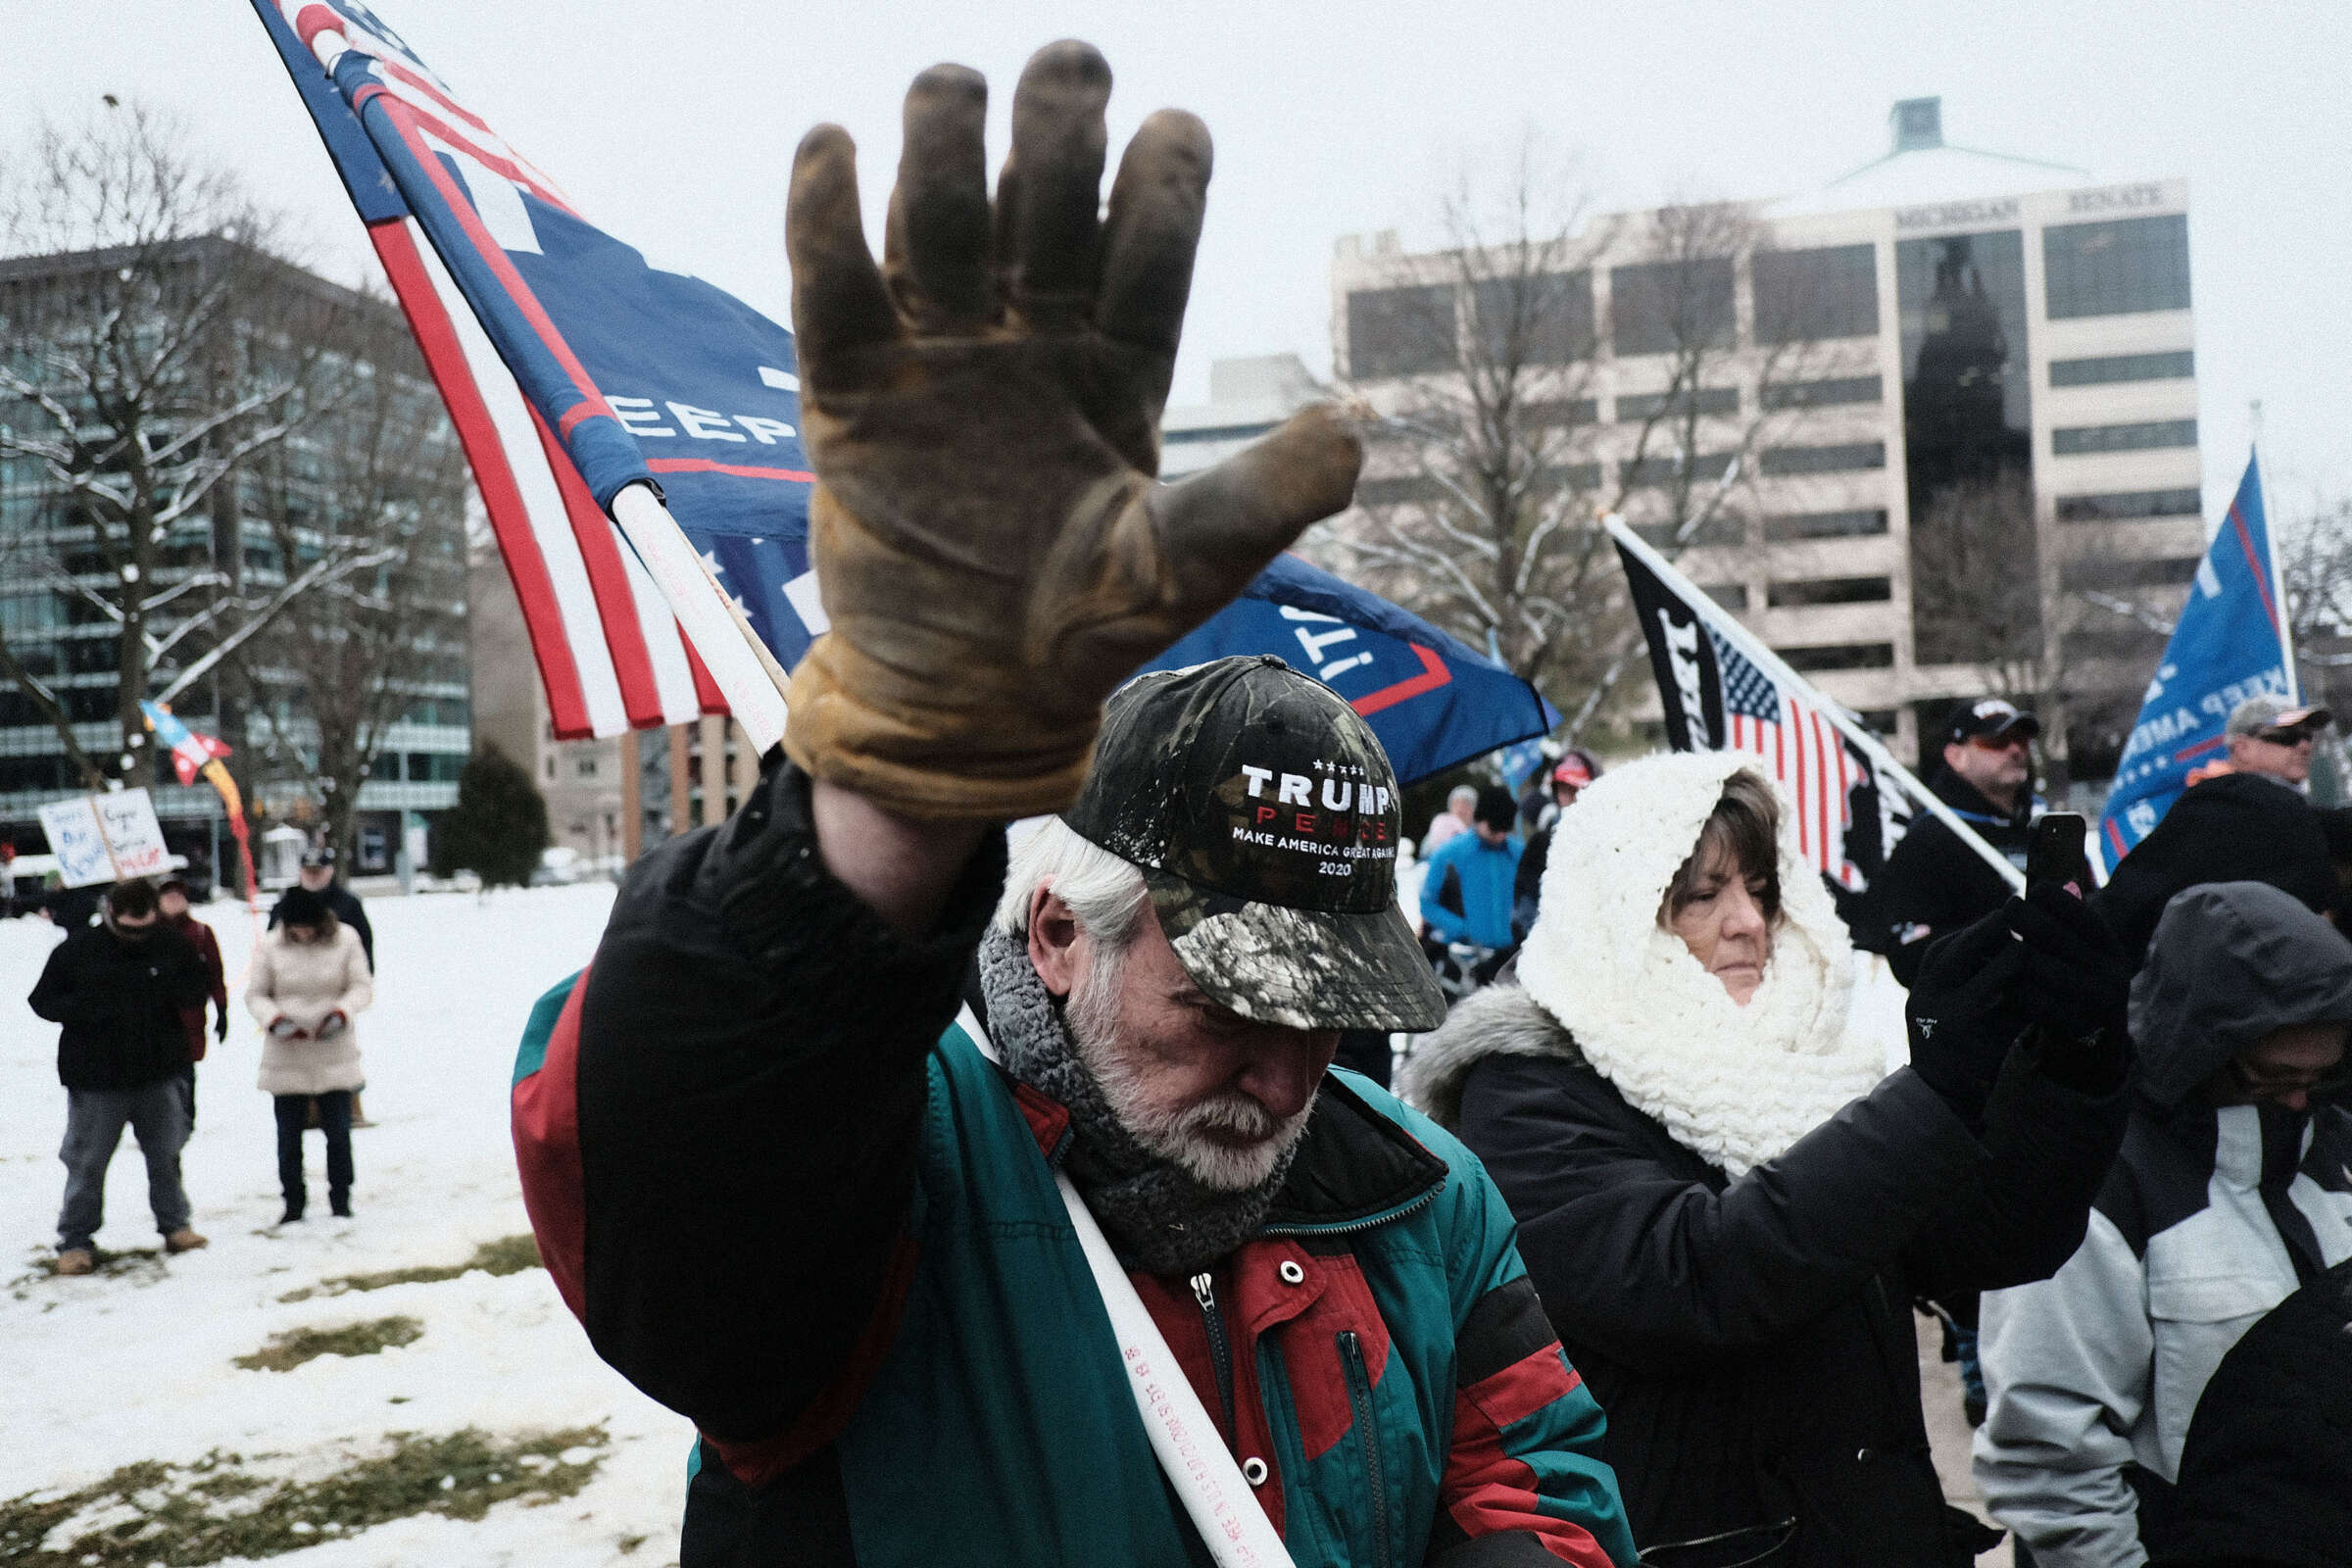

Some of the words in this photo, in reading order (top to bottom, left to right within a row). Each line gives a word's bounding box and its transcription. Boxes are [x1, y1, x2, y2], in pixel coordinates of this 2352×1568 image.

[604, 396, 797, 444] EEP
[1242, 764, 1390, 815] TRUMP
[1256, 807, 1387, 841] PENCE
[1233, 827, 1274, 846] MAKE
[1278, 838, 1339, 857] AMERICA
[1343, 847, 1370, 859] GREAT
[1319, 861, 1351, 876] 2020
